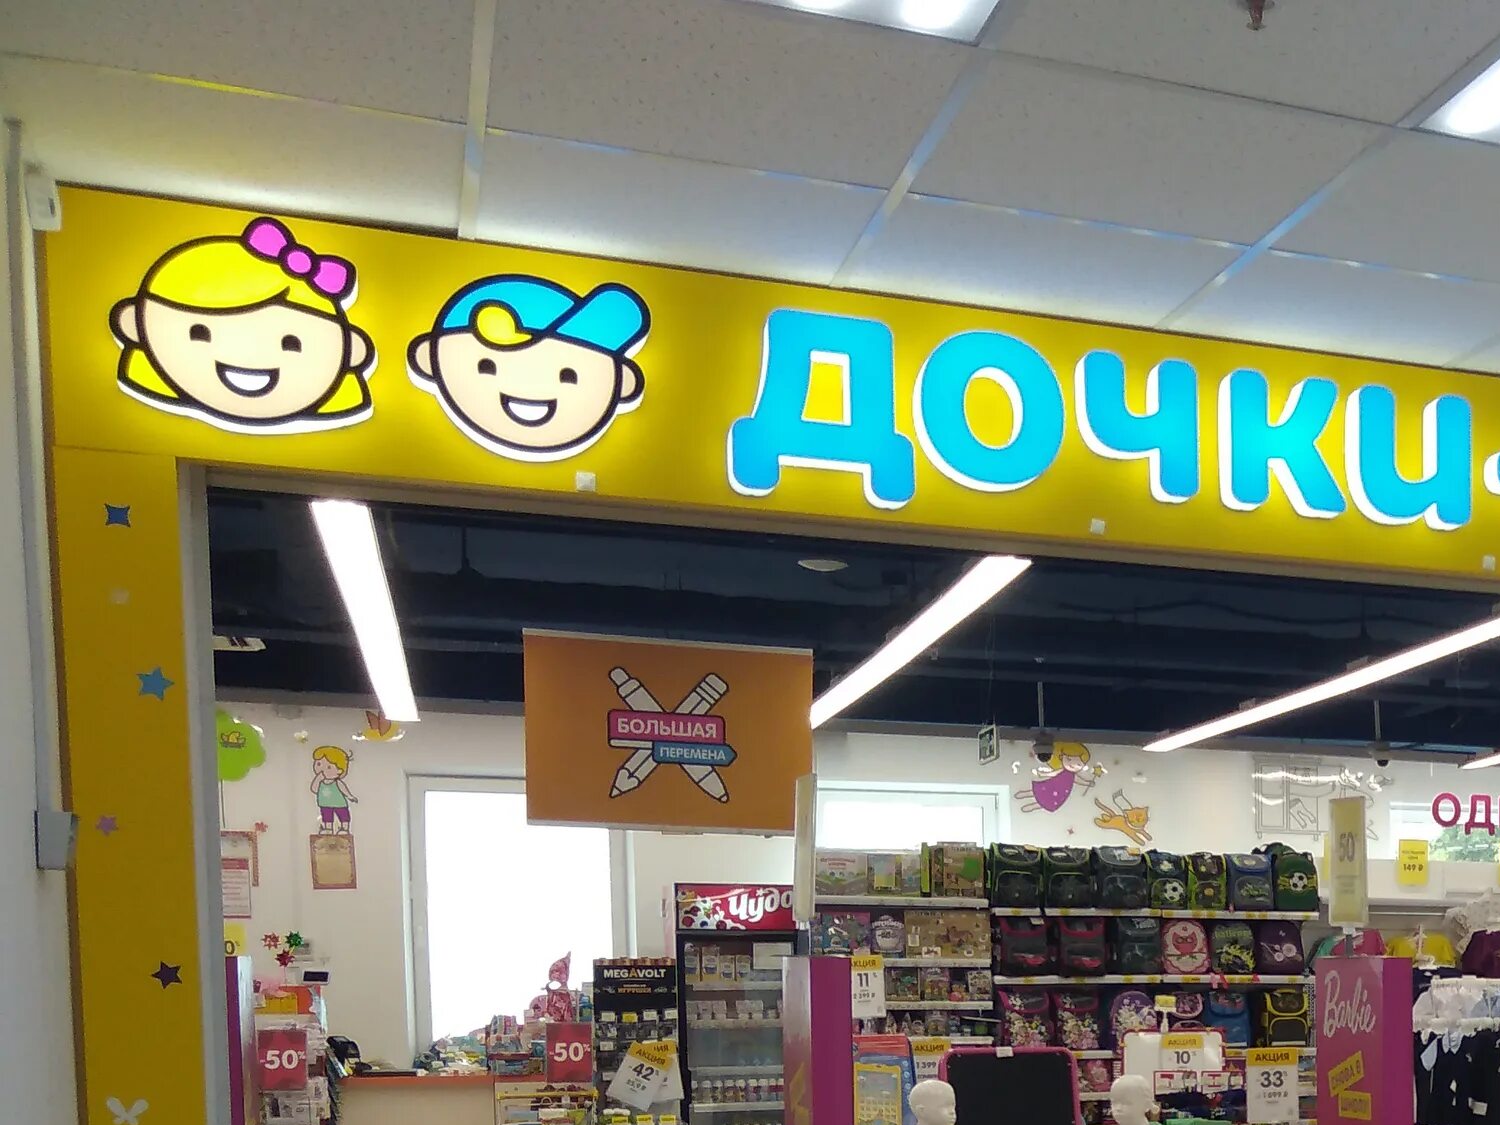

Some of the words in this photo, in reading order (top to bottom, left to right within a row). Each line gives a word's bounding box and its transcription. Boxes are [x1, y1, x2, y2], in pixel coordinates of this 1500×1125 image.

[617, 717, 717, 738] БОЛЬШАЯ
[660, 747, 726, 761] ПЕРЕМЕНА
[603, 968, 667, 979] MEGAVOLT
[1323, 970, 1376, 1038] Barbie
[1255, 1052, 1290, 1062] АКЦИЯ
